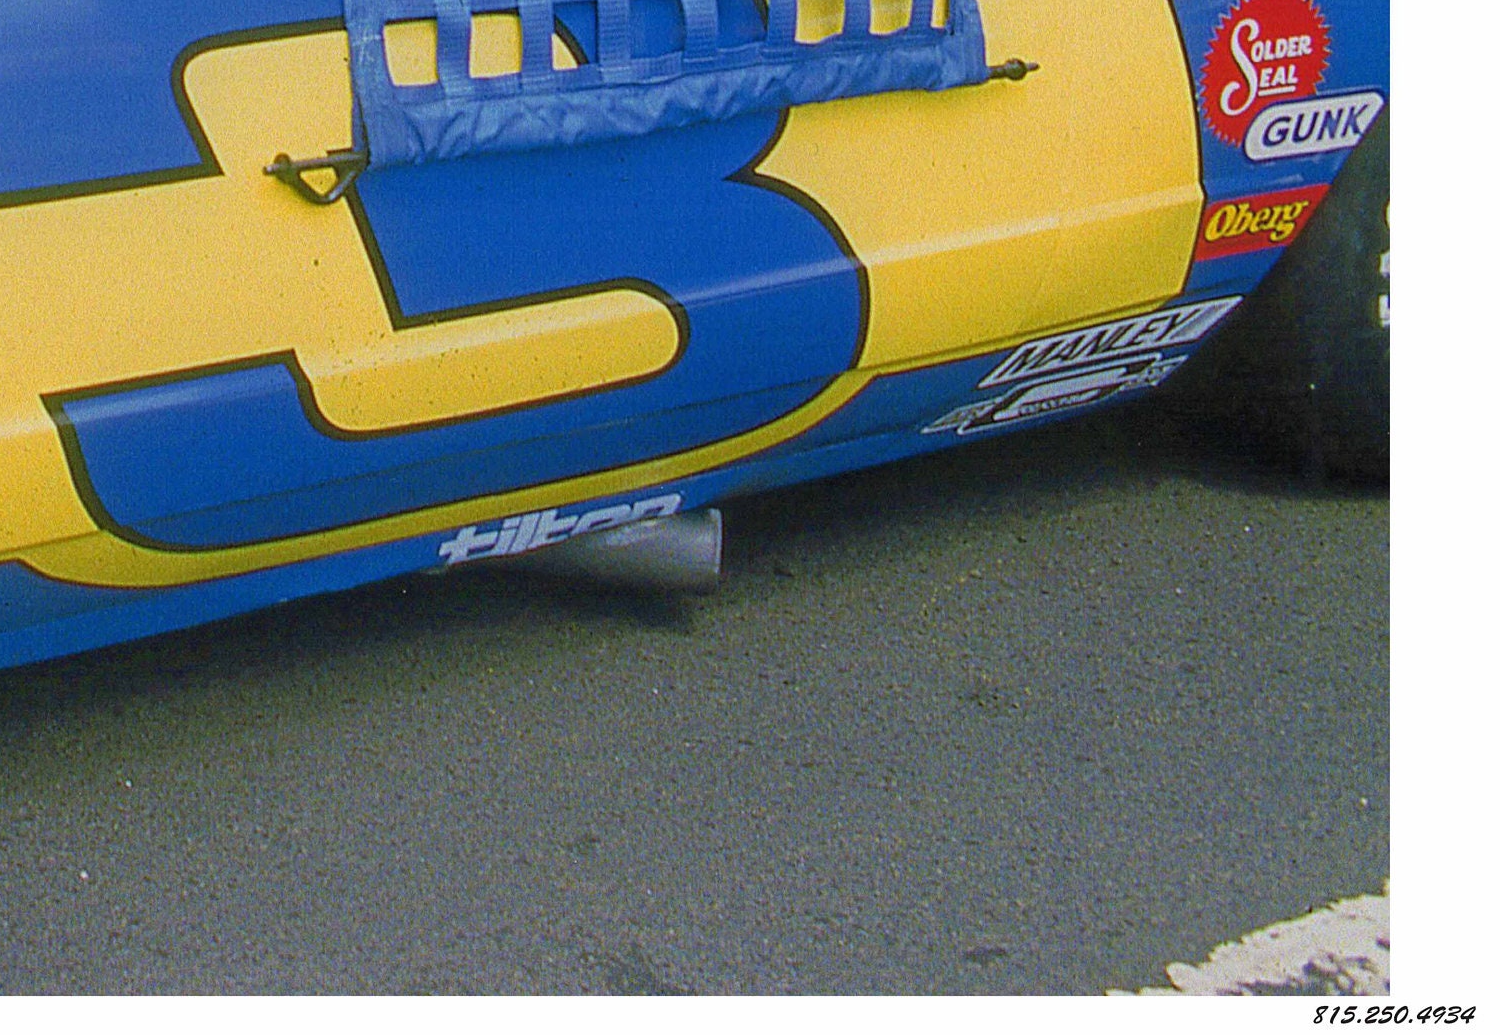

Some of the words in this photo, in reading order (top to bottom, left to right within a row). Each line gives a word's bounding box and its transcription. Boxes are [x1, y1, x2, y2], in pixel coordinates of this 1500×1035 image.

[1262, 103, 1370, 147] GUNK
[1205, 199, 1309, 242] Oberg
[1000, 308, 1200, 380] MANLEY
